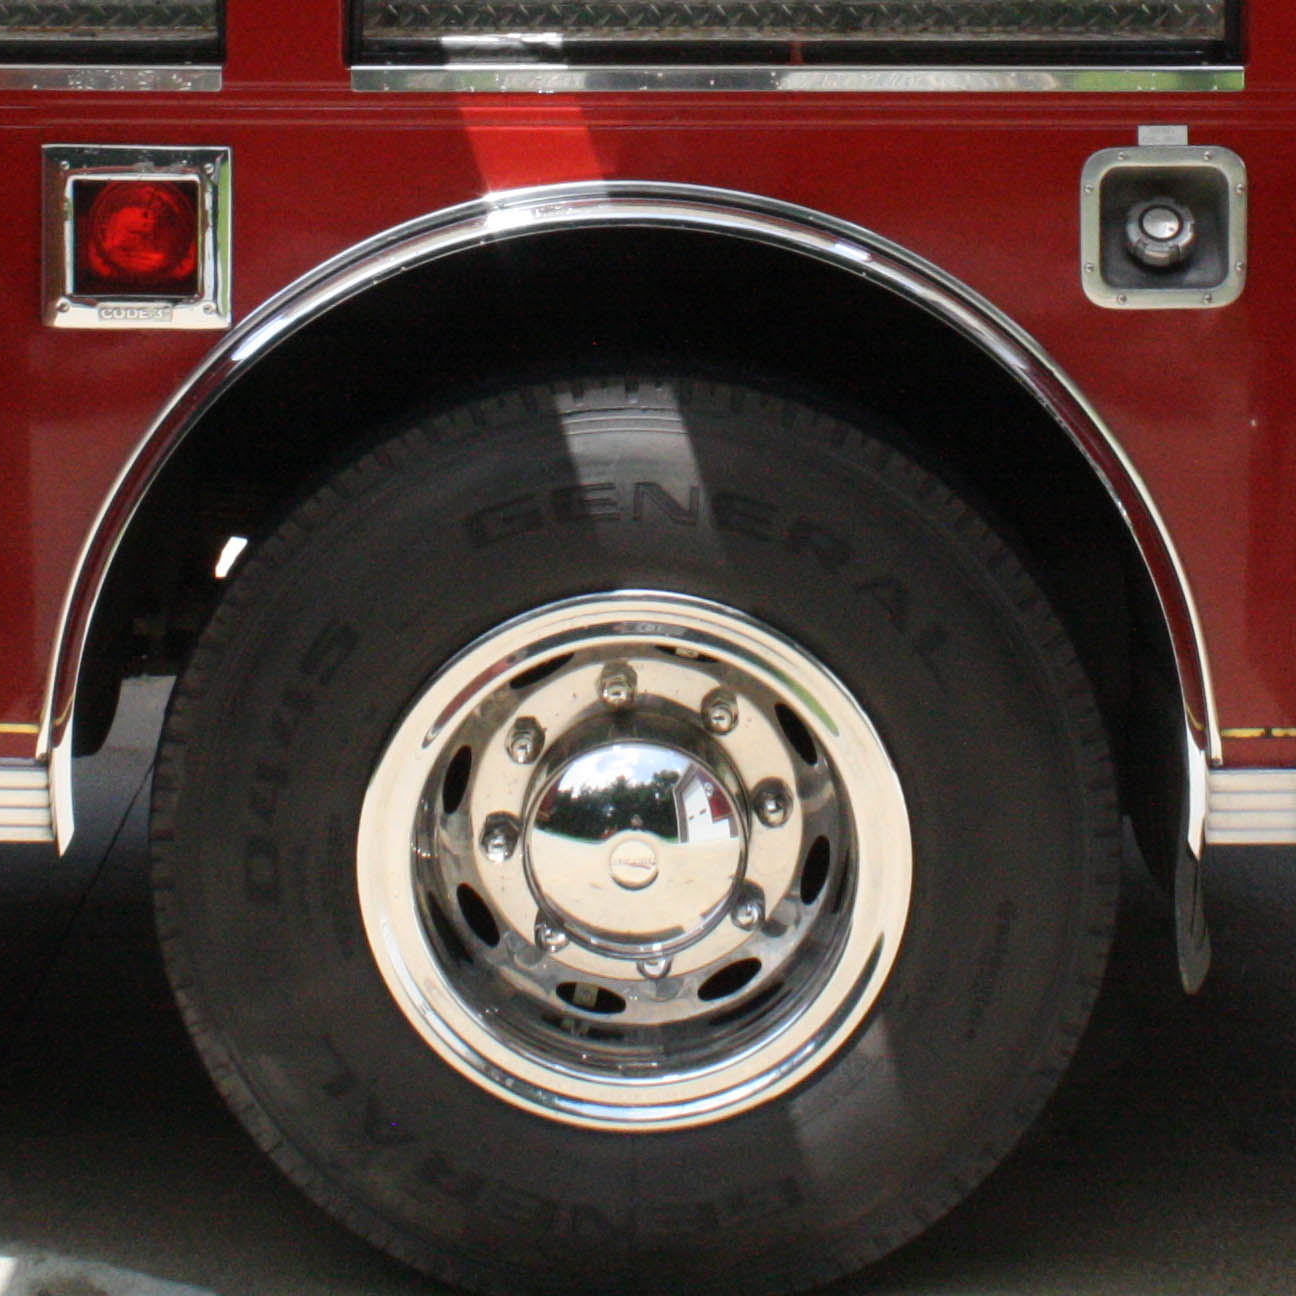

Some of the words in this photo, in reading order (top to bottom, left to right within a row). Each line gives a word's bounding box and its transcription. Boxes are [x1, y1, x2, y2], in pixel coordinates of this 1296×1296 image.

[100, 307, 151, 319] CODE
[152, 307, 163, 319] 3
[460, 480, 945, 688] GENERAL
